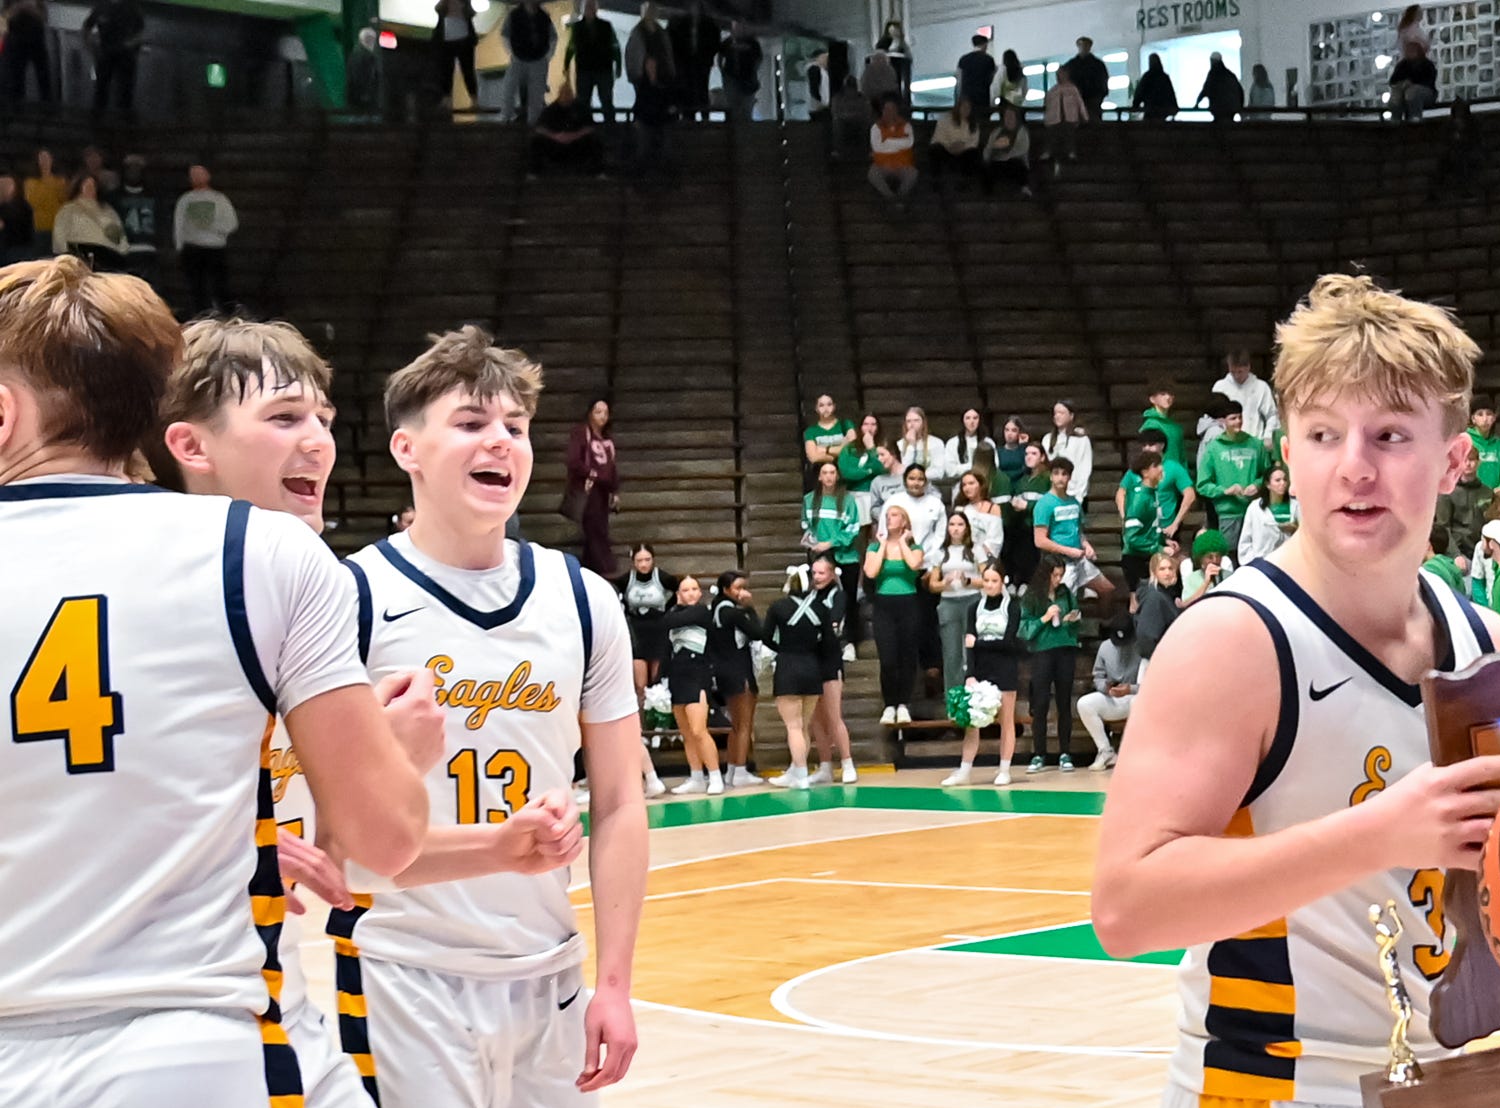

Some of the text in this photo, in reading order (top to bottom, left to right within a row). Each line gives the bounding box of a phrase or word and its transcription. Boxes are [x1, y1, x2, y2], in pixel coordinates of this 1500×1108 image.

[1136, 0, 1240, 30] RESTROOMS
[10, 594, 125, 775] 4
[425, 654, 561, 730] Eagles
[447, 748, 531, 824] 13
